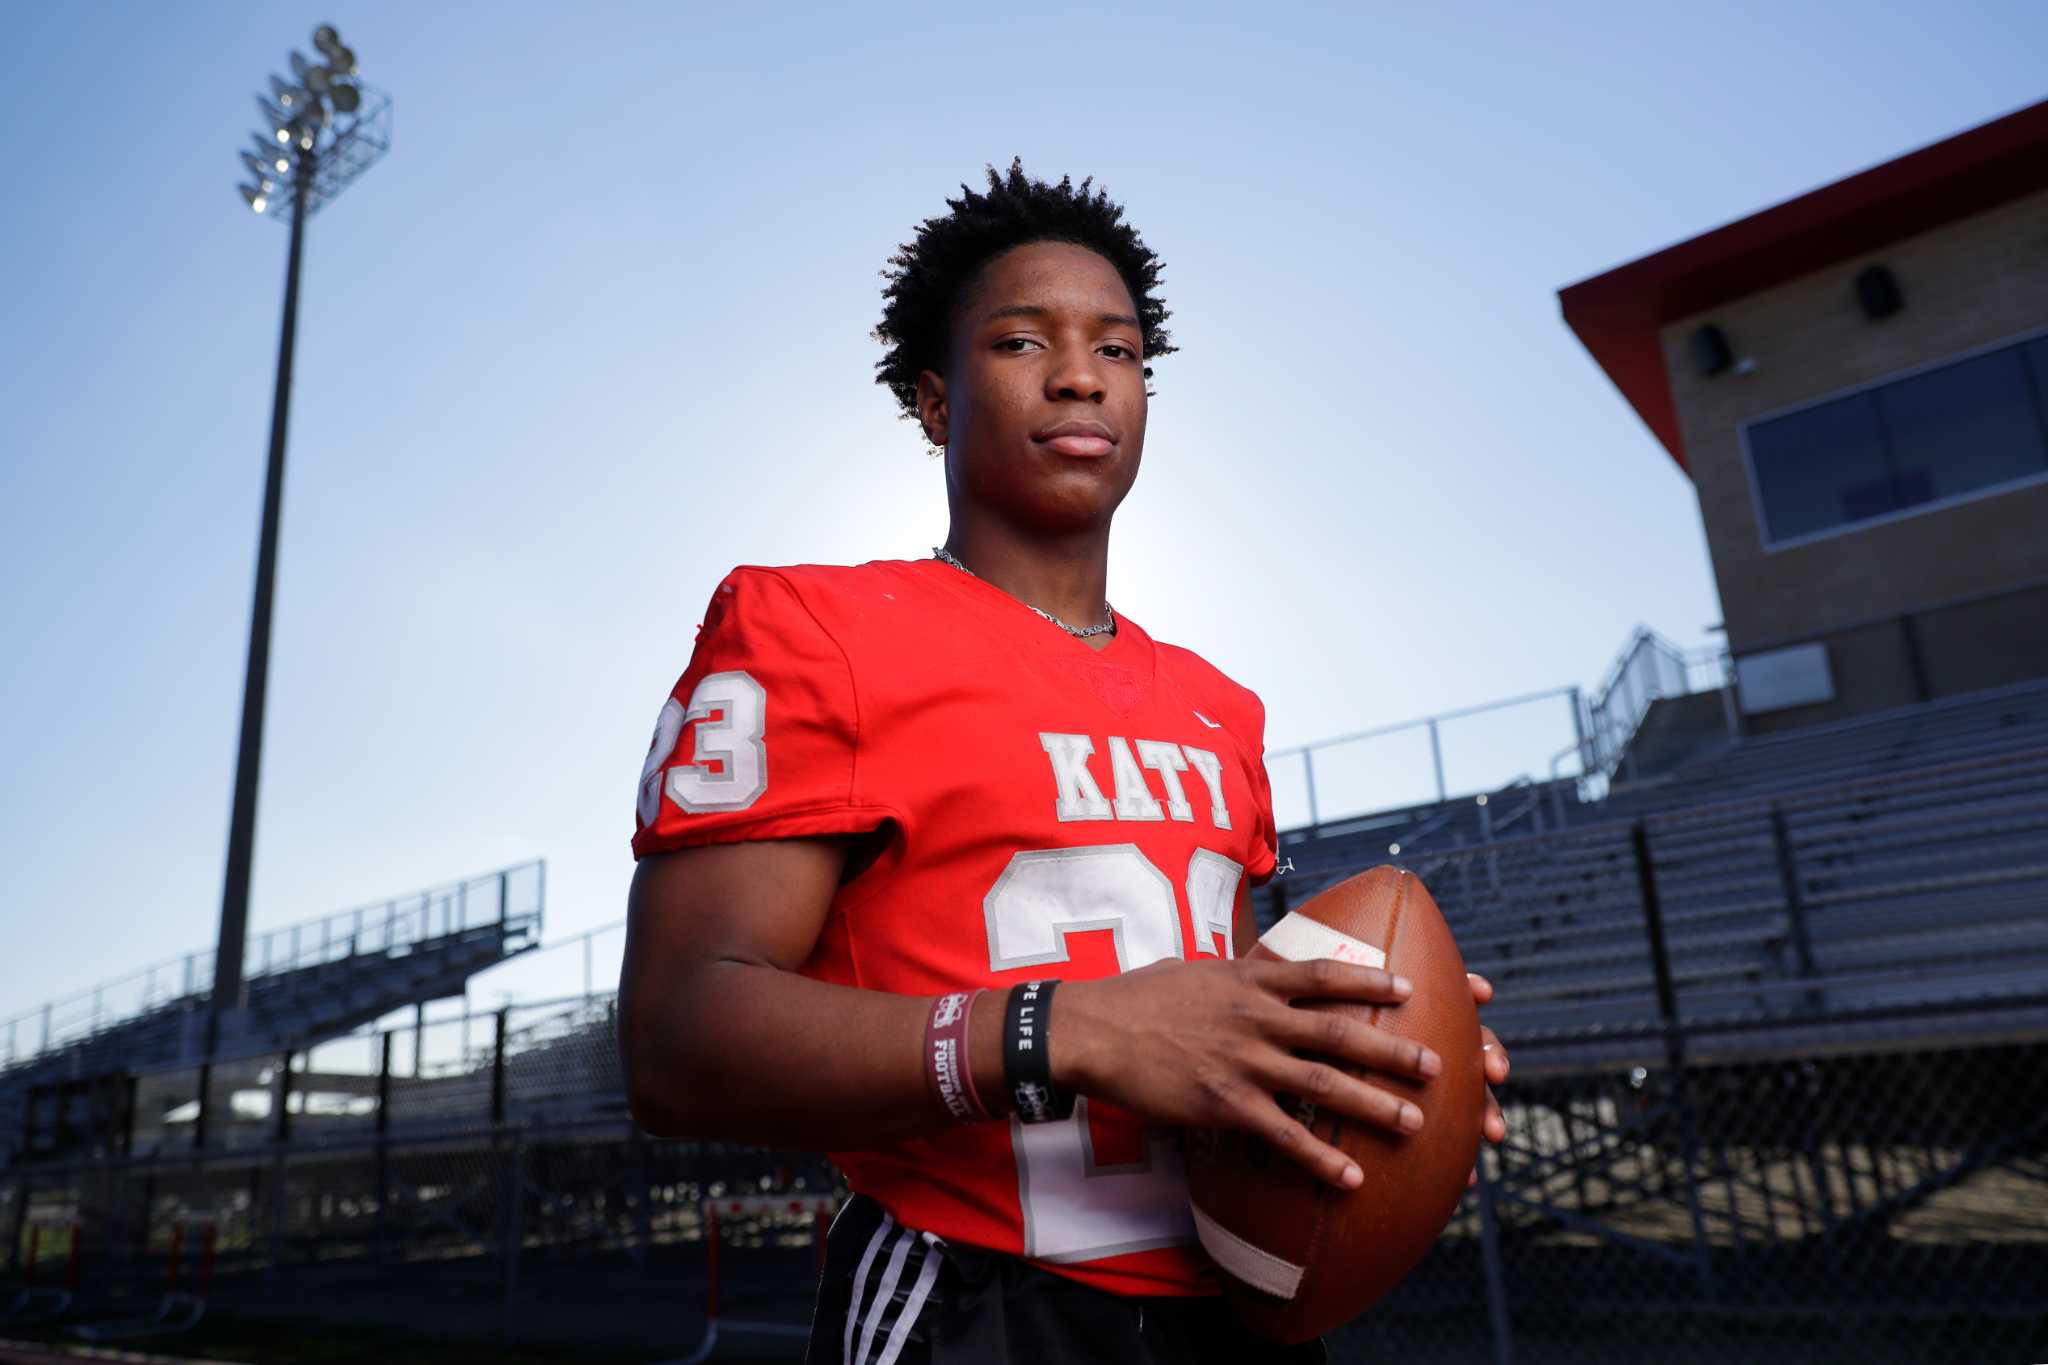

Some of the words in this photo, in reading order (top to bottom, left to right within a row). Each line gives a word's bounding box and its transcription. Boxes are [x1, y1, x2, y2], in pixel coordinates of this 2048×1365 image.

[636, 671, 768, 828] 23
[1038, 732, 1232, 830] KATY
[1018, 1006, 1035, 1051] LIFE
[1023, 980, 1041, 1001] PE
[933, 1039, 965, 1117] FOOTBALL
[983, 843, 1244, 1264] 2
